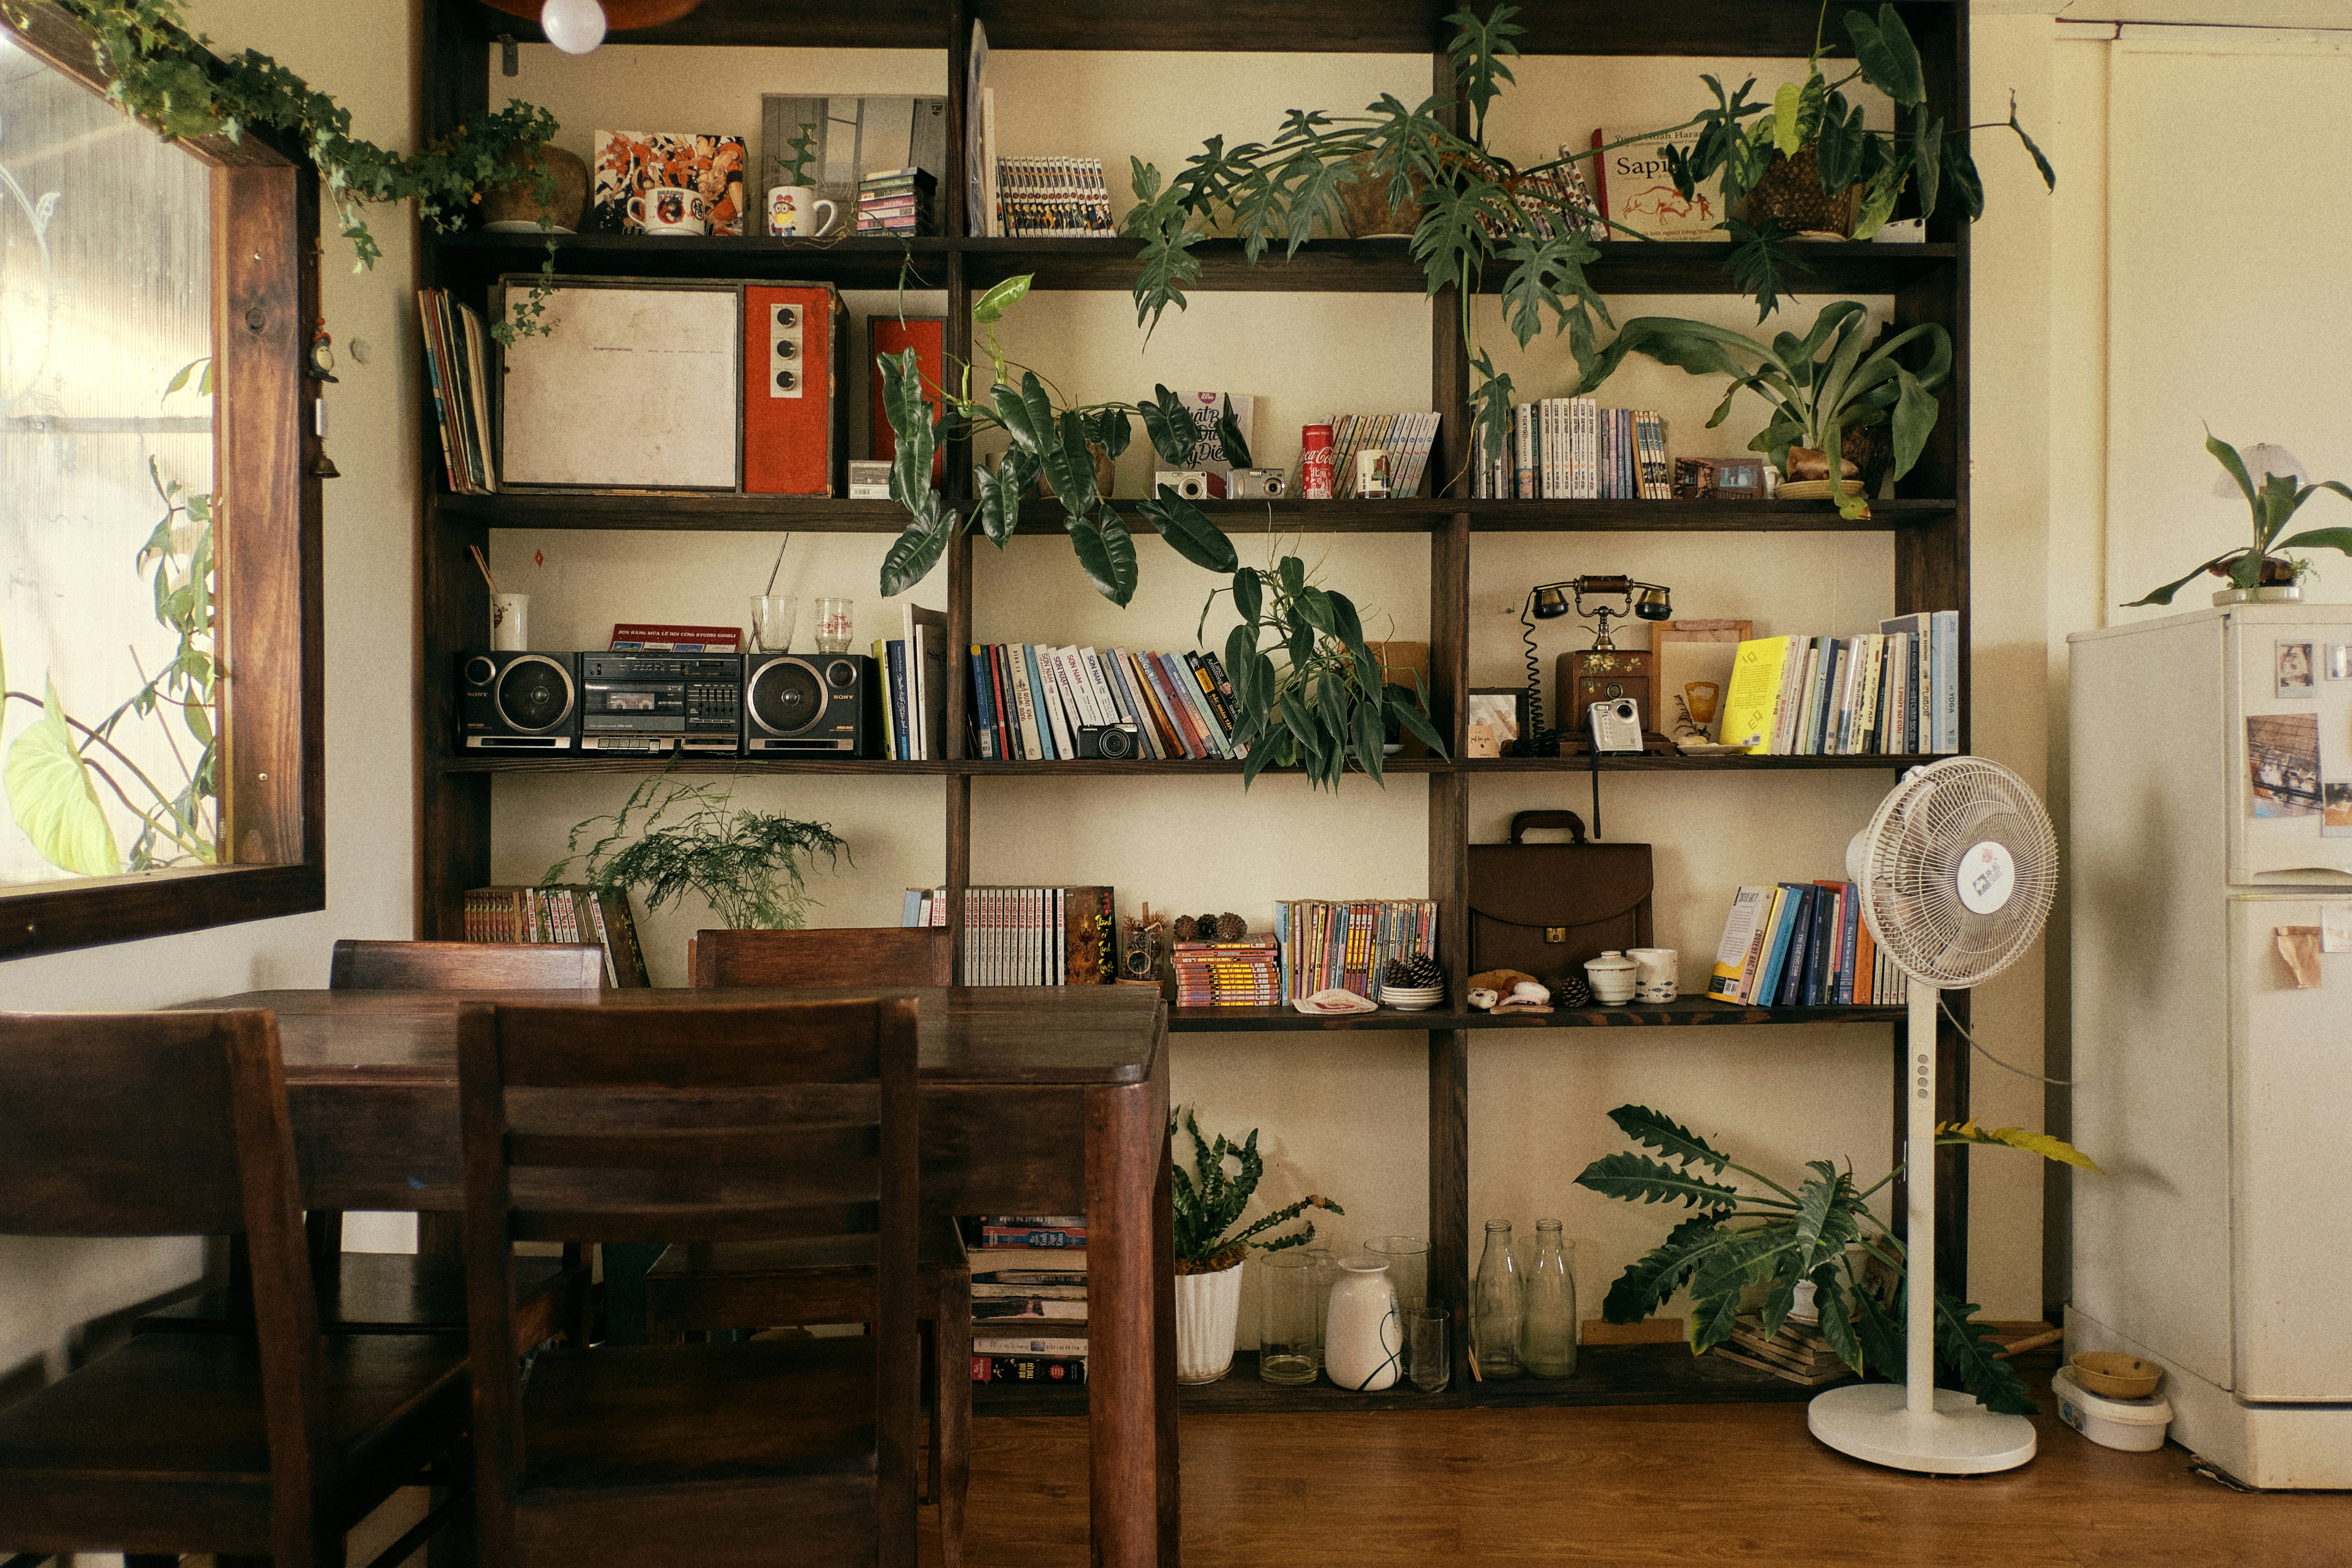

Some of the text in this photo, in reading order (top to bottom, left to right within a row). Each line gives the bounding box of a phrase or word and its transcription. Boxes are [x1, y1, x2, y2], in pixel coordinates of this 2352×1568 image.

[1617, 158, 1669, 179] Sapi
[1045, 668, 1054, 683] NAM
[1072, 669, 1082, 684] NAM
[1092, 670, 1102, 684] NAM
[1207, 658, 1223, 685] Armstrong
[1214, 661, 1225, 677] Lance
[1058, 670, 1068, 686] NAM
[1750, 929, 1763, 955] CONTENT
